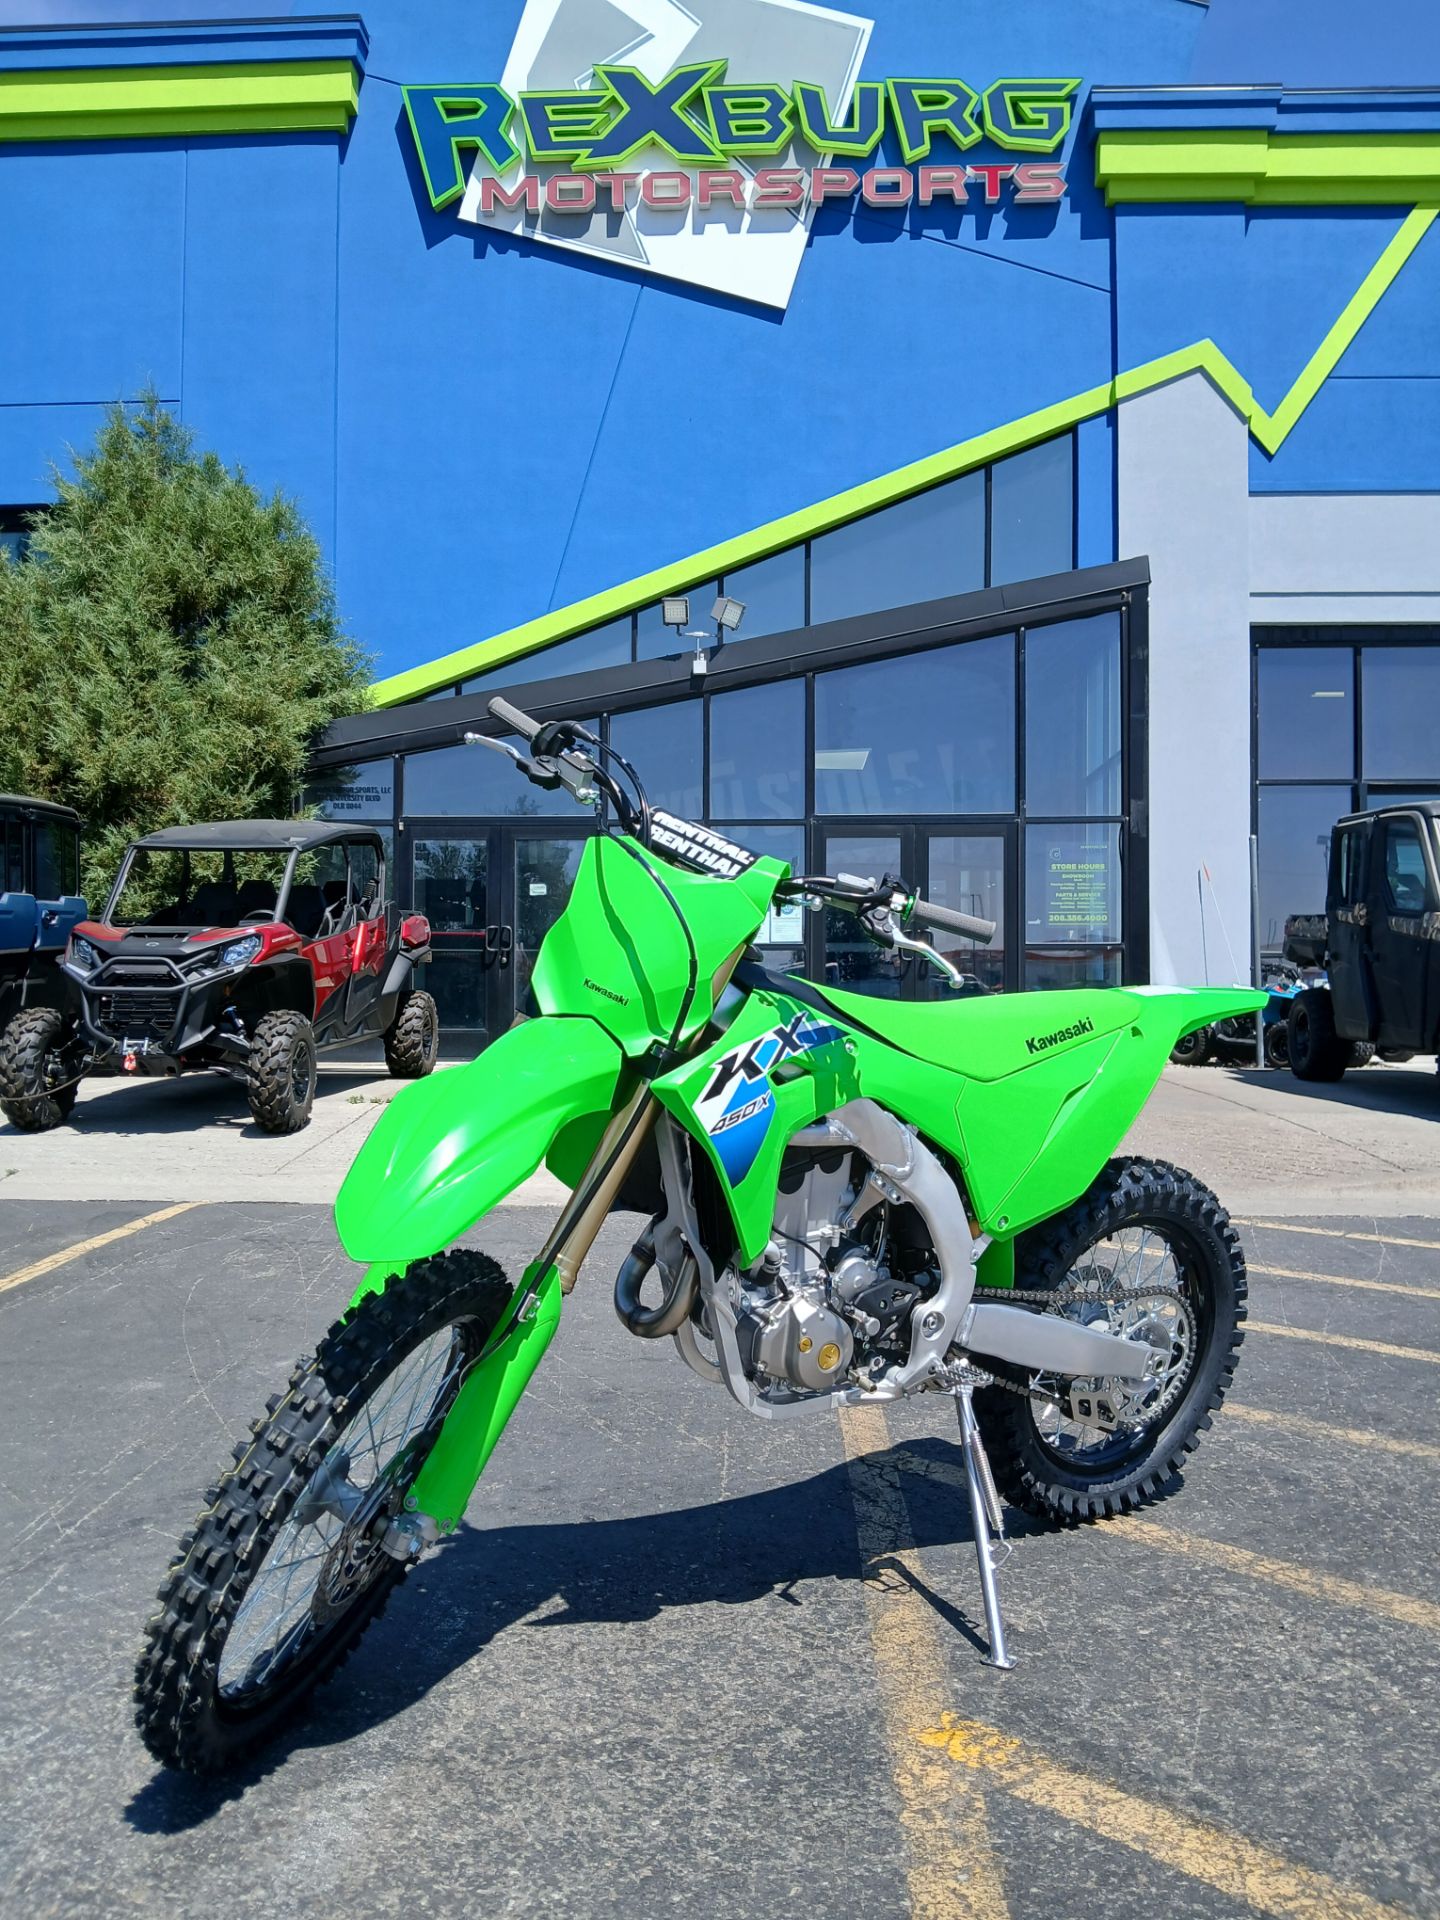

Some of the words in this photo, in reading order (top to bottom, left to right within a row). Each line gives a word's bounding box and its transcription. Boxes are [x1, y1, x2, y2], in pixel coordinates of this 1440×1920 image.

[402, 58, 1083, 212] REXBURG
[481, 163, 1068, 215] MOTORSPORTS
[381, 786, 392, 794] LLC
[652, 811, 751, 865] RENTHAL
[583, 978, 629, 1007] Kawasaki
[700, 1011, 809, 1104] KX
[1025, 1016, 1094, 1054] Kawasaki
